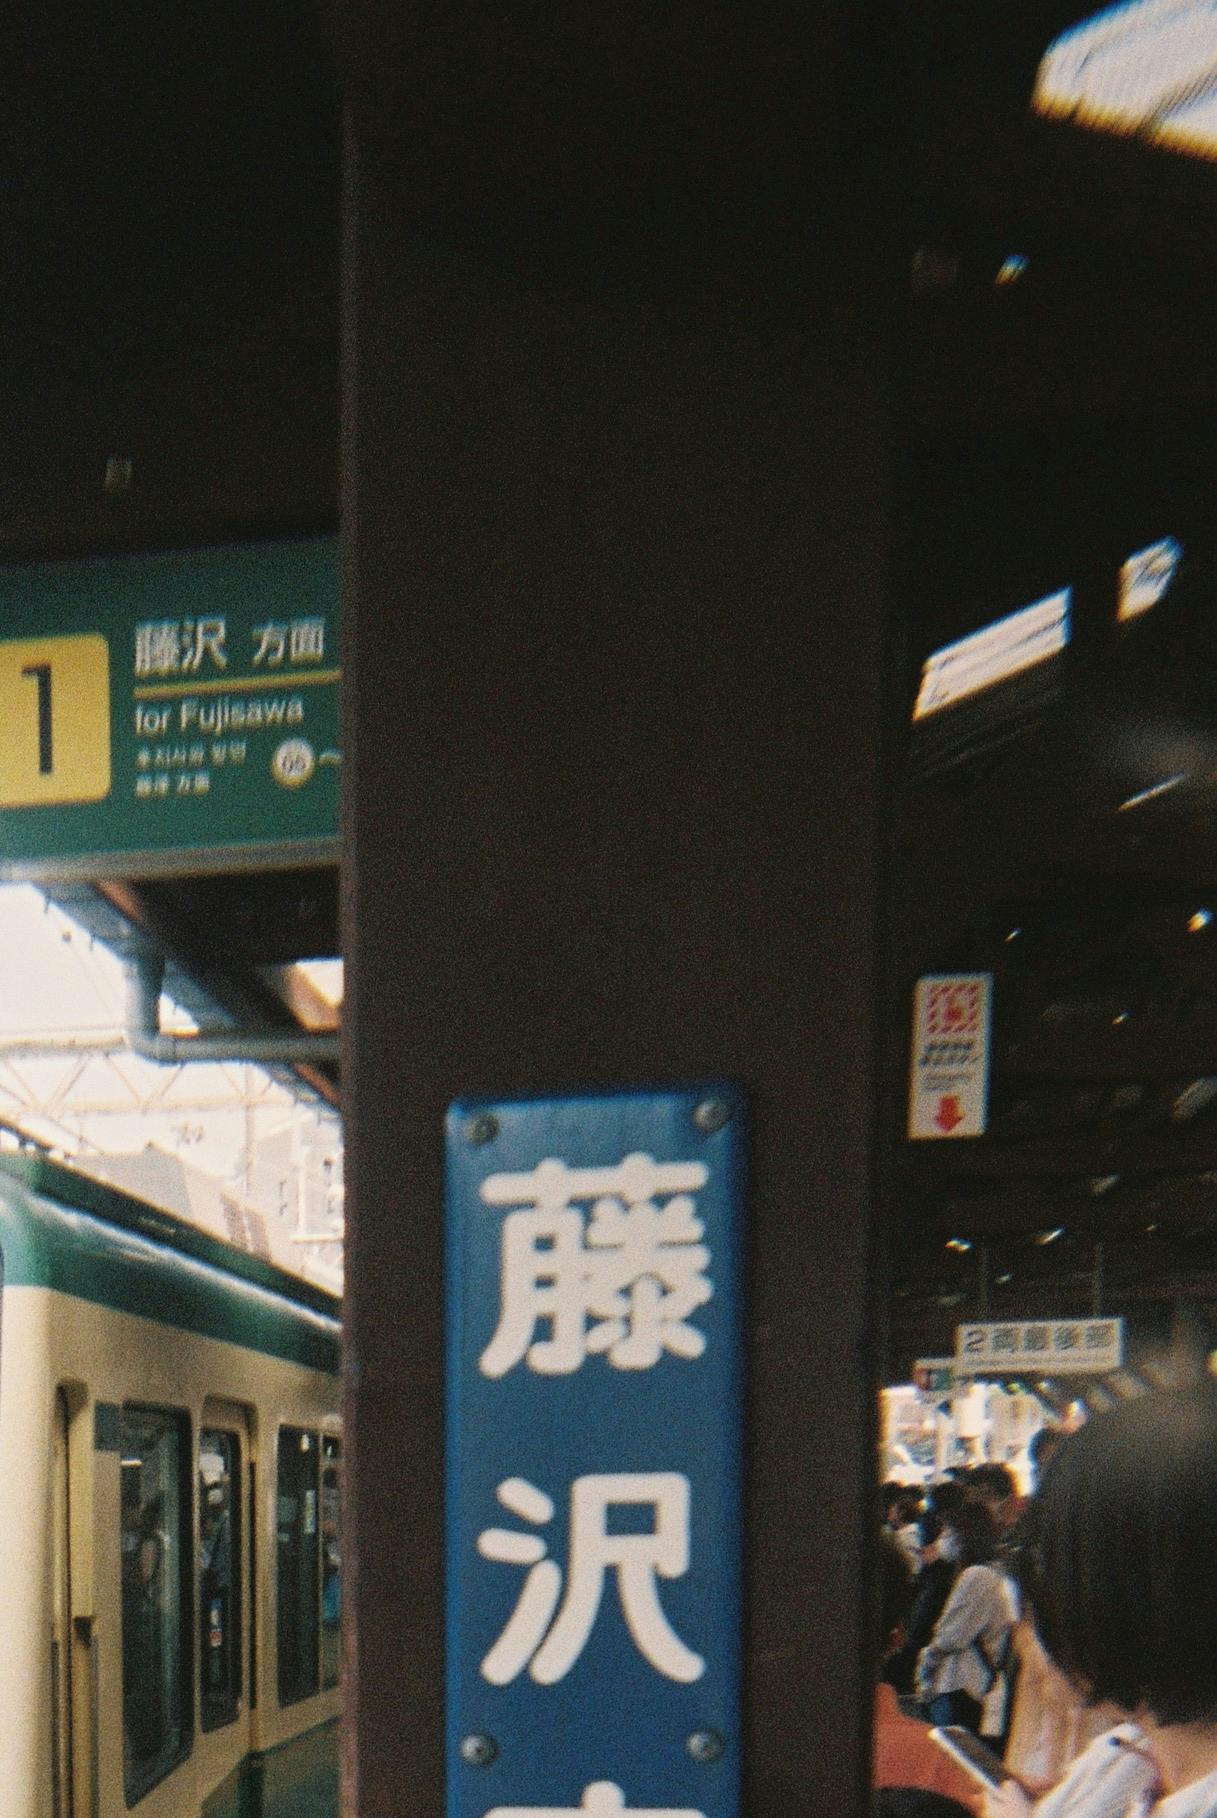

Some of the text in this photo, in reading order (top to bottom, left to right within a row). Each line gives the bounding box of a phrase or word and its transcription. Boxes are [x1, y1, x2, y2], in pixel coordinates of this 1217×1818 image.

[252, 615, 326, 668] 方面
[20, 661, 53, 776] 1
[134, 696, 304, 736] for Fujisawa
